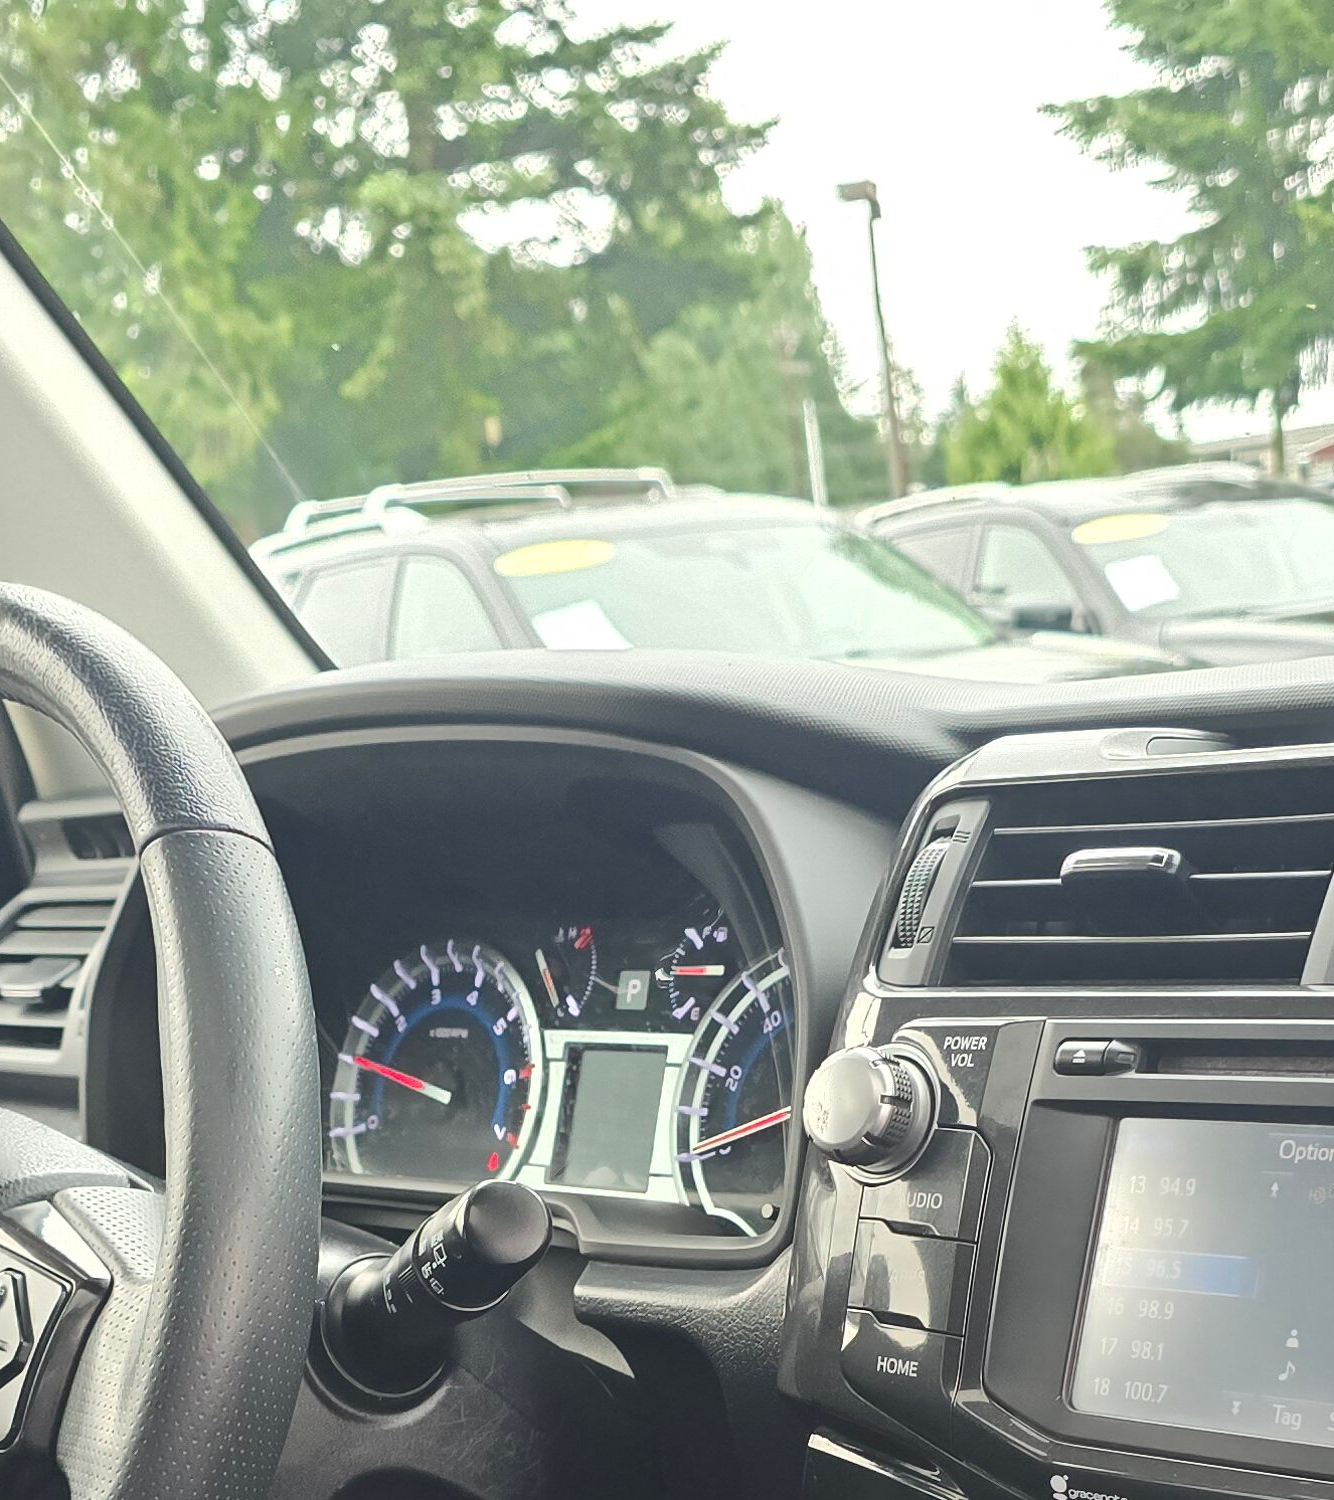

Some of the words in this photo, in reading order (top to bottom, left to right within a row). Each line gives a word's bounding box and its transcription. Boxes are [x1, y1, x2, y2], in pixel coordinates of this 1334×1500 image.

[467, 990, 479, 1006] 4
[493, 1017, 507, 1036] 5
[763, 1010, 782, 1034] 40
[943, 1036, 987, 1051] POWER
[950, 1053, 975, 1068] VOL
[725, 1065, 743, 1092] 20
[1130, 1175, 1147, 1194] 13
[1160, 1177, 1196, 1197] 94.9
[896, 1191, 943, 1209] UDIO
[1154, 1217, 1190, 1239] 95.7
[1147, 1258, 1183, 1279] 96.5
[1138, 1300, 1175, 1320] 98.9
[1100, 1337, 1118, 1356] 17
[1130, 1339, 1164, 1361] 98.1
[876, 1355, 918, 1377] HOME
[1093, 1376, 1111, 1397] 18
[1124, 1380, 1168, 1404] 100.7
[1272, 1403, 1302, 1431] Tag
